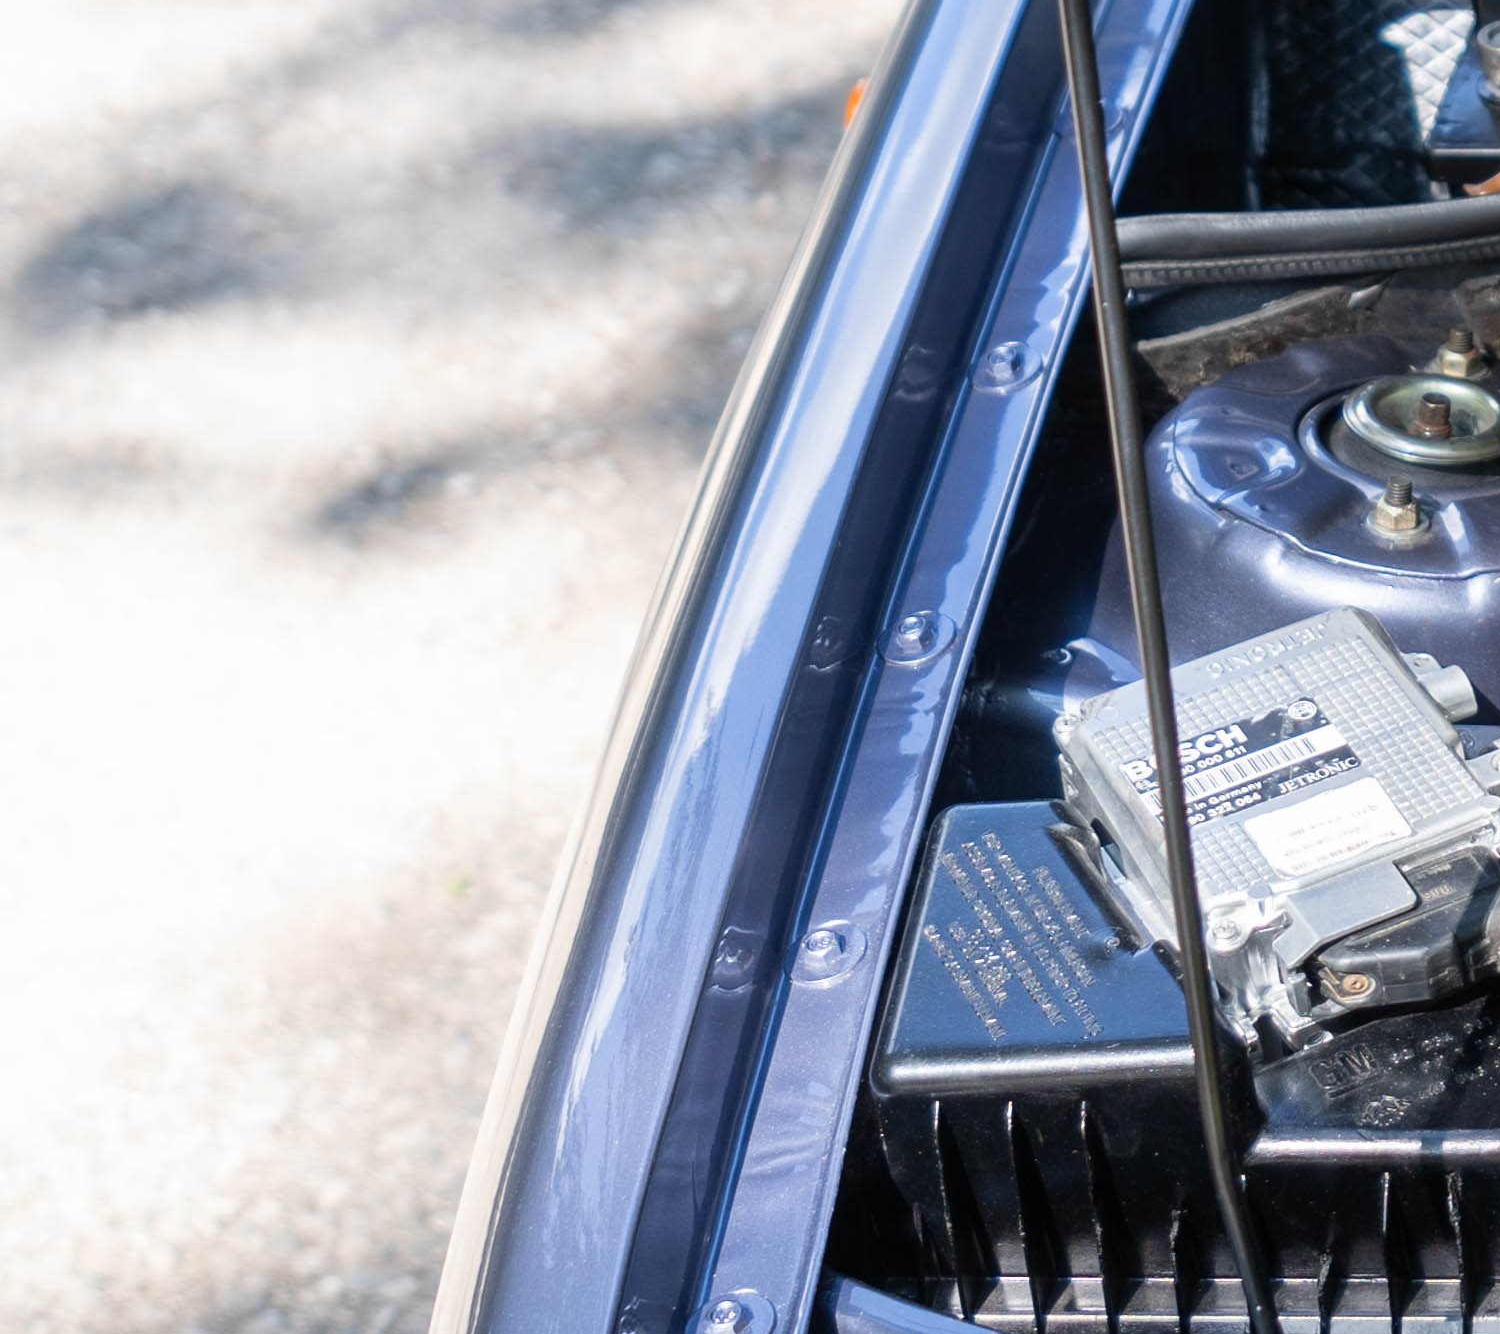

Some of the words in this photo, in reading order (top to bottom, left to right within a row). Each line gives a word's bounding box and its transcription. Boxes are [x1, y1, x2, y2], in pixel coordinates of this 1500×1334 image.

[1121, 724, 1249, 782] BSCH
[1207, 780, 1263, 808] Germany
[1279, 755, 1360, 795] JETRONIC
